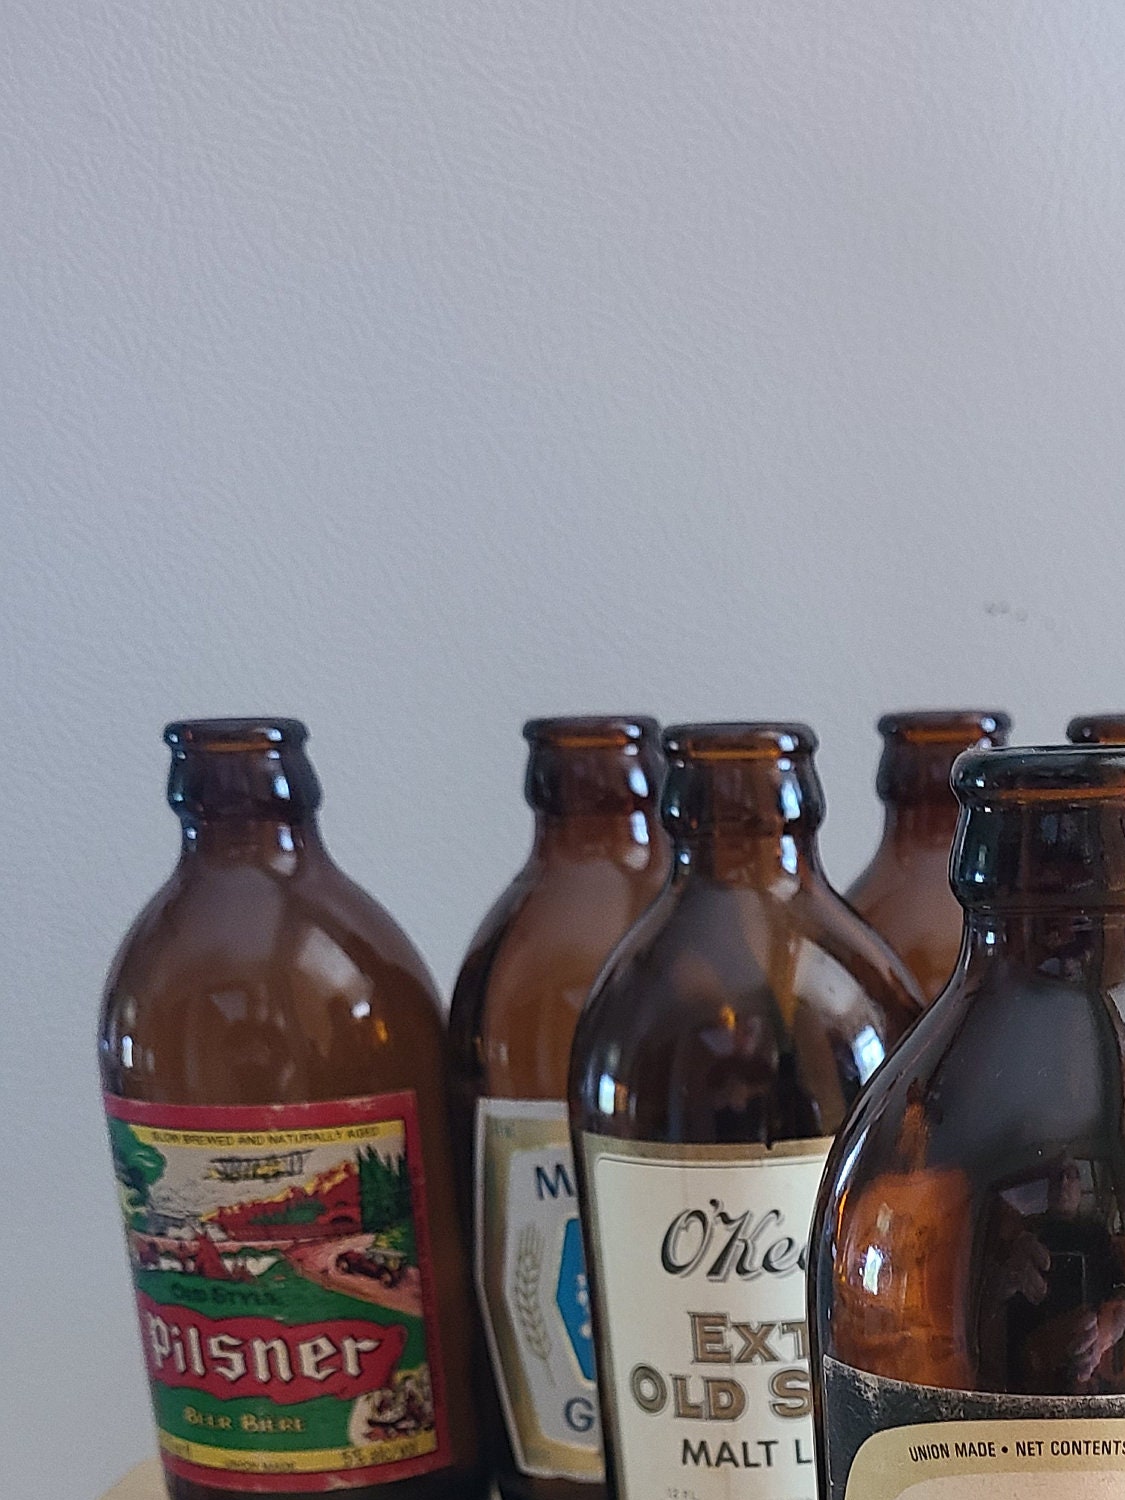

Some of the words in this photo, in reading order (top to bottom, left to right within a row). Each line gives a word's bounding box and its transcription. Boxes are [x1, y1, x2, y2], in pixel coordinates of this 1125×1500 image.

[184, 1134, 234, 1146] BREWED
[238, 1135, 263, 1146] AND
[268, 1131, 342, 1145] NATURALLY
[534, 1164, 575, 1200] M
[661, 1198, 808, 1283] O'Ke
[146, 1311, 381, 1384] Pilsner
[687, 1311, 809, 1365] EXT
[629, 1362, 747, 1422] OLD
[769, 1365, 812, 1420] S
[183, 1406, 233, 1429] BEER
[564, 1397, 595, 1433] G
[682, 1438, 779, 1468] MALT
[795, 1438, 813, 1464] L
[909, 1442, 950, 1463] UNION
[954, 1441, 997, 1459] MADE
[1016, 1440, 1043, 1457] NET
